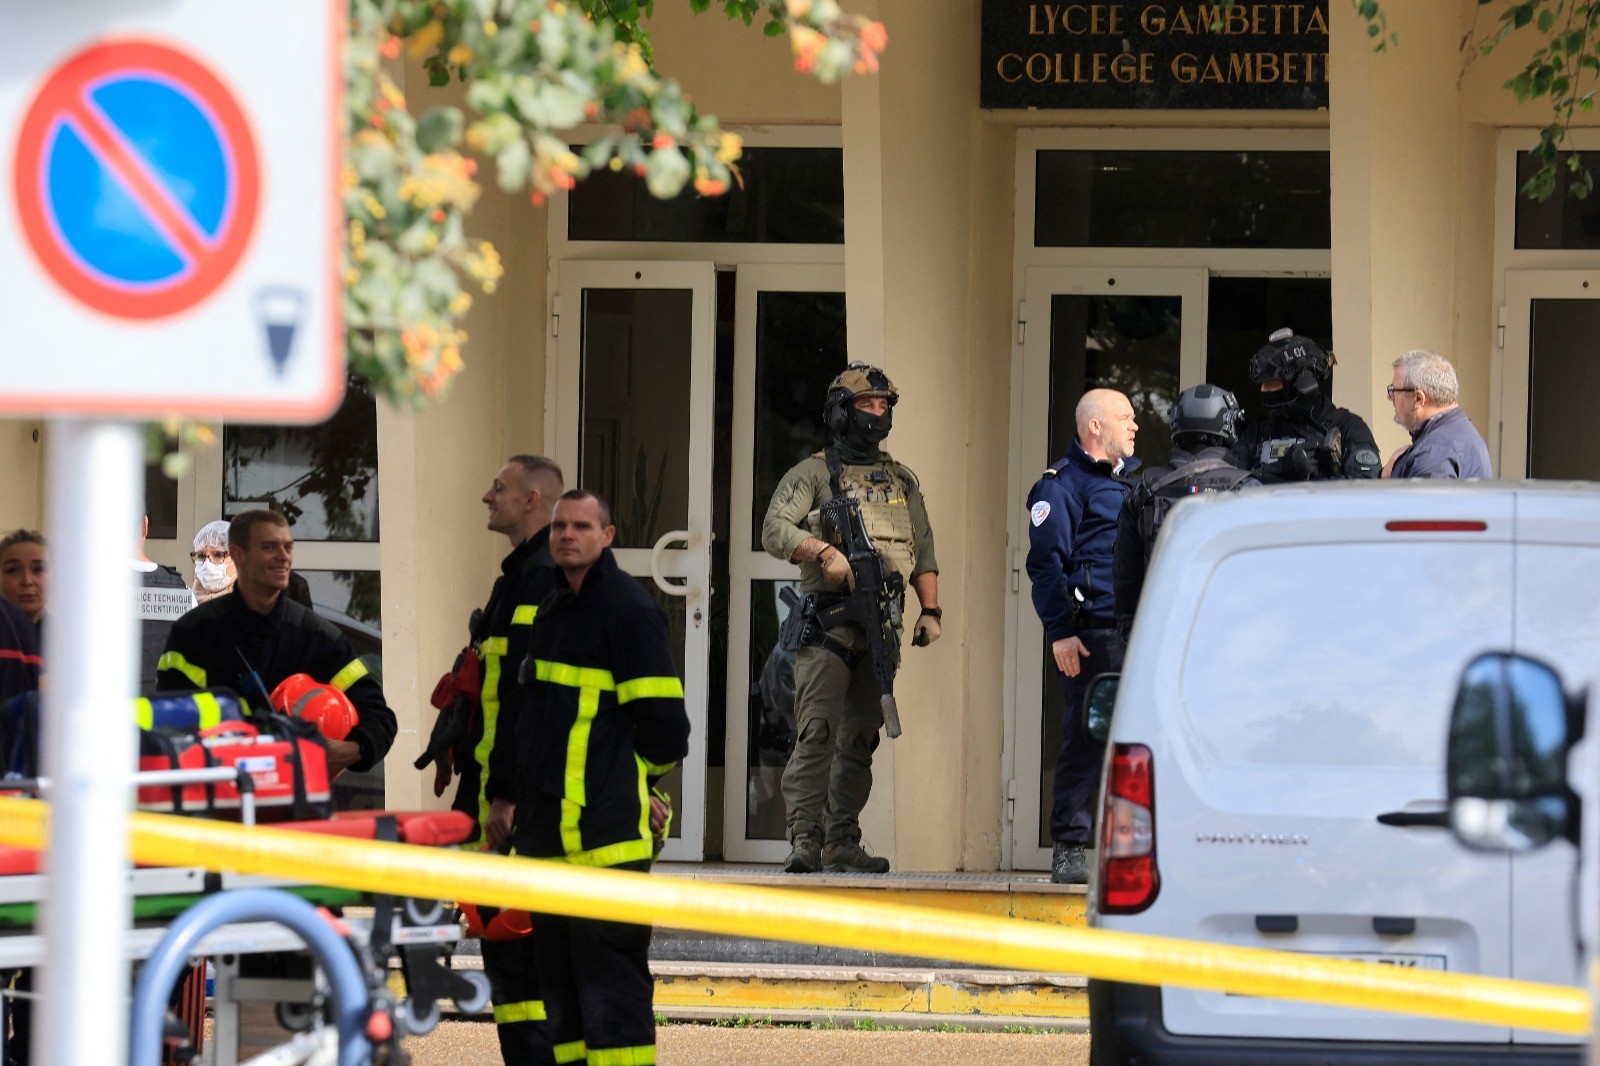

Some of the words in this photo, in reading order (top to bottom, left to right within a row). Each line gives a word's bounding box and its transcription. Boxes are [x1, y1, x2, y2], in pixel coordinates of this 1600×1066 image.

[1028, 4, 1125, 35] LYCEE
[1140, 4, 1329, 36] GAMBETTA
[997, 52, 1155, 83] COLLEGE
[154, 594, 192, 604] TECHNIQUE
